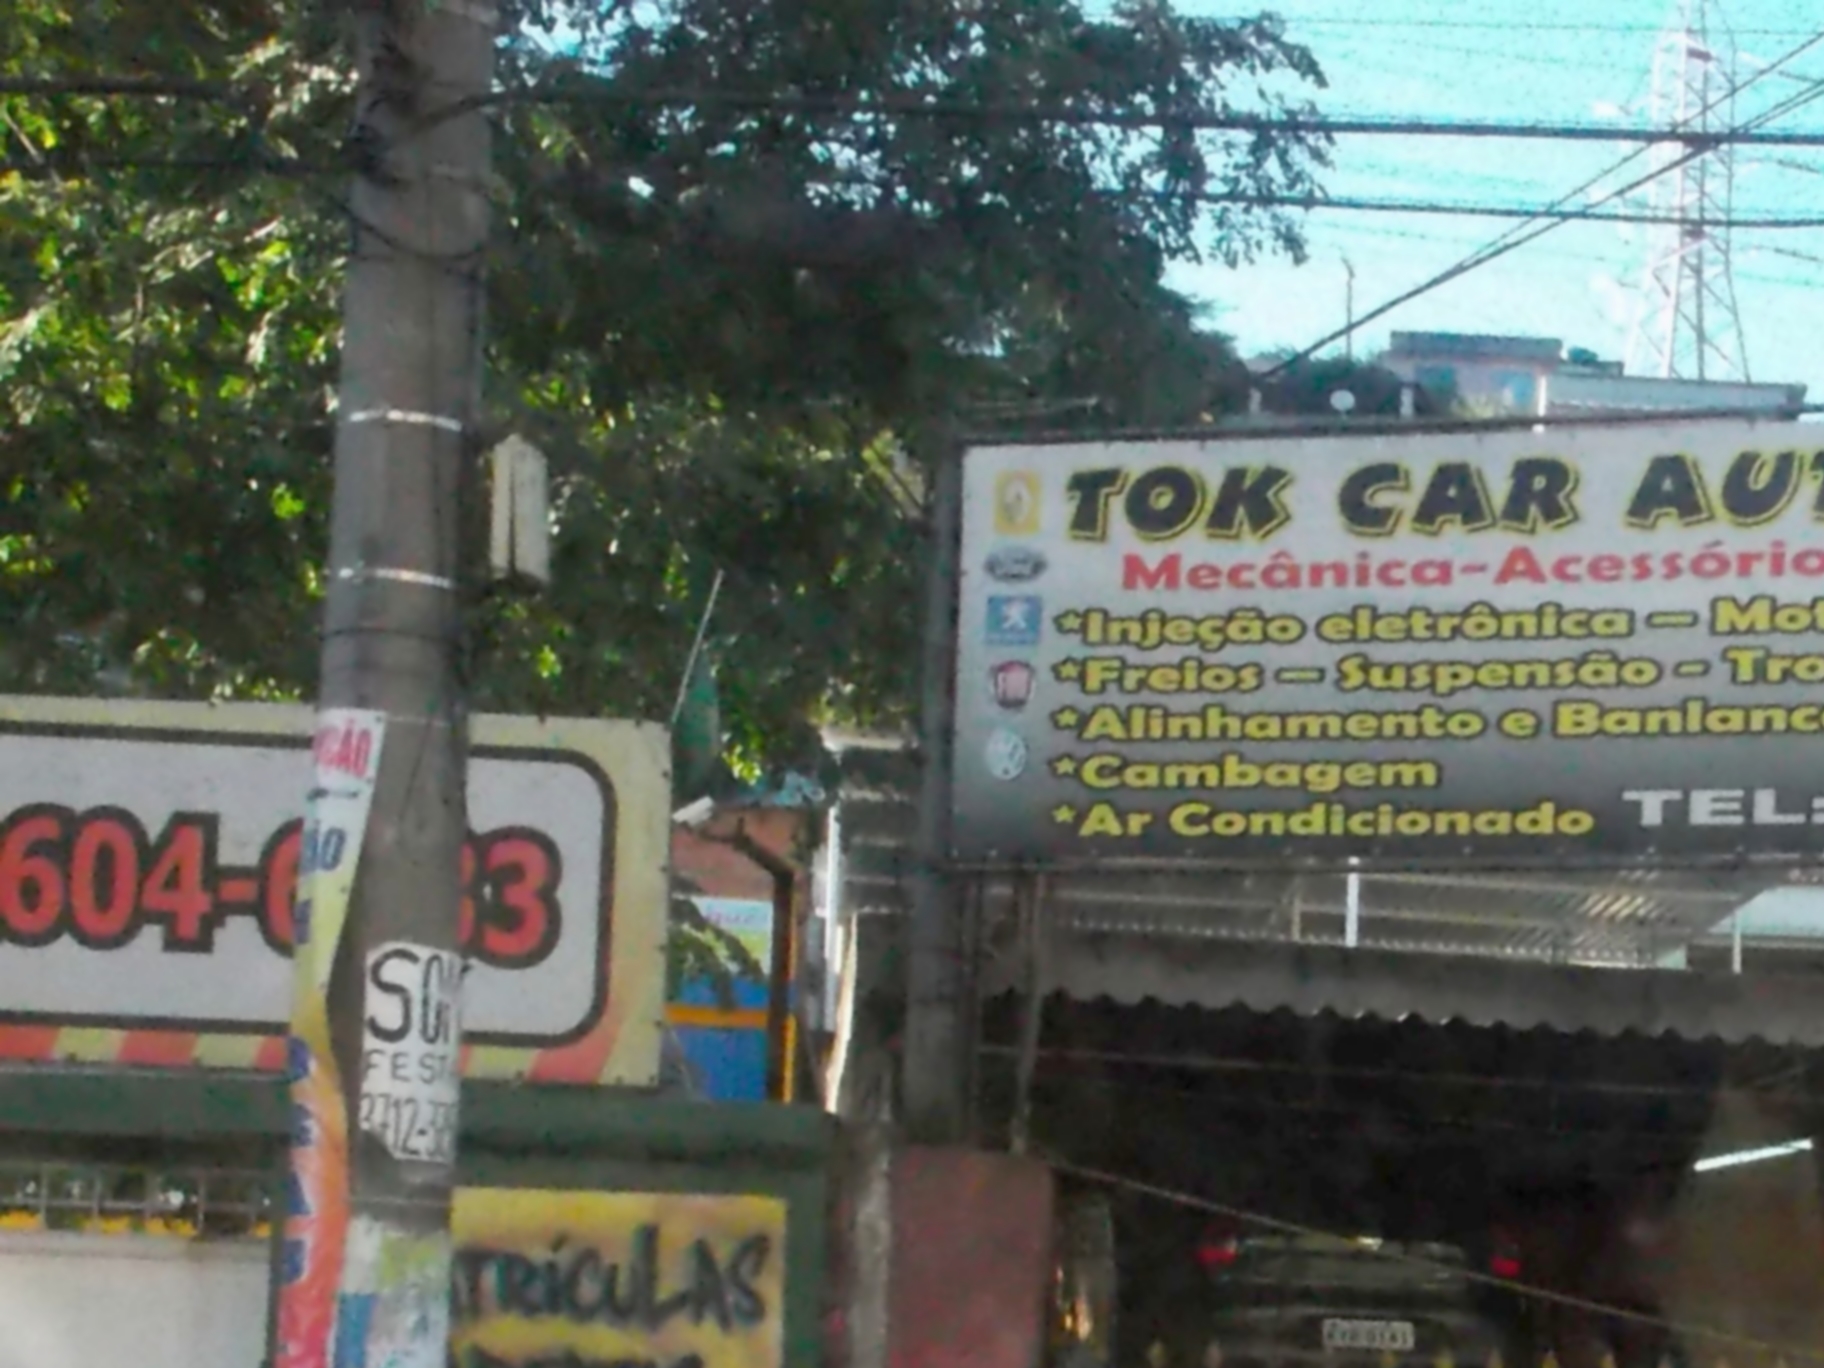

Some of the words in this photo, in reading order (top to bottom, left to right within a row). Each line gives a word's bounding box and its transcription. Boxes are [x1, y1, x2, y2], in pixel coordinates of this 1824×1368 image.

[1065, 462, 1291, 542] TOK
[1337, 455, 1580, 538] CAR
[1315, 600, 1634, 645] eletrônica
[1334, 649, 1662, 697] Suspensão
[1499, 706, 1540, 738] e
[1167, 799, 1597, 840] Condicionado
